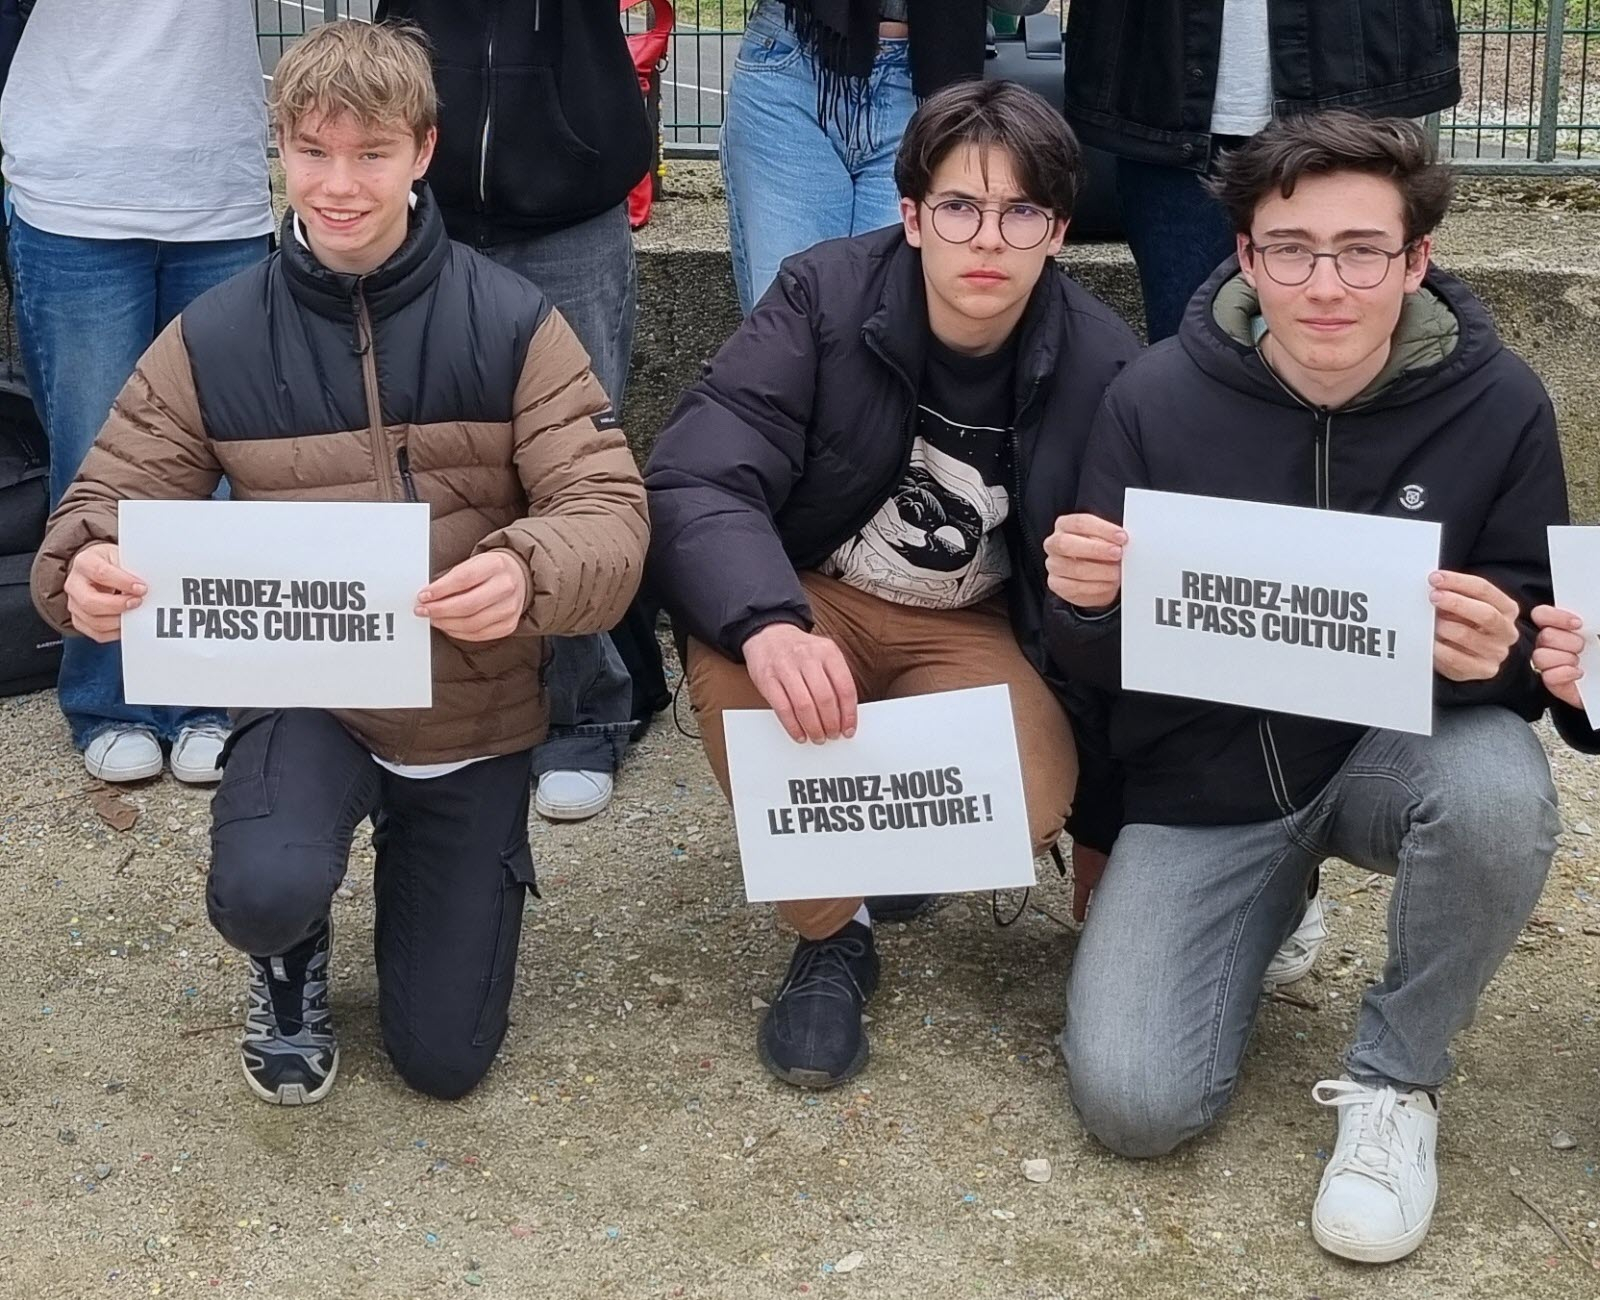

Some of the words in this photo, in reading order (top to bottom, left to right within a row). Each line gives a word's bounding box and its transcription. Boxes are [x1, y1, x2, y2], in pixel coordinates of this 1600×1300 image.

[182, 577, 366, 612] RENDEZ-NOUS
[1182, 570, 1368, 623] RENDEZ-NOUS
[156, 607, 183, 638] LE
[189, 608, 258, 640] PASS
[264, 610, 381, 642] CULTURE
[1155, 597, 1182, 628] LE
[1187, 601, 1256, 638] PASS
[1262, 612, 1381, 658] CULTURE
[788, 767, 963, 805] RENDEZ-NOUS
[767, 808, 795, 835] LE
[797, 804, 865, 834] PASS
[868, 795, 981, 831] CULTURE
